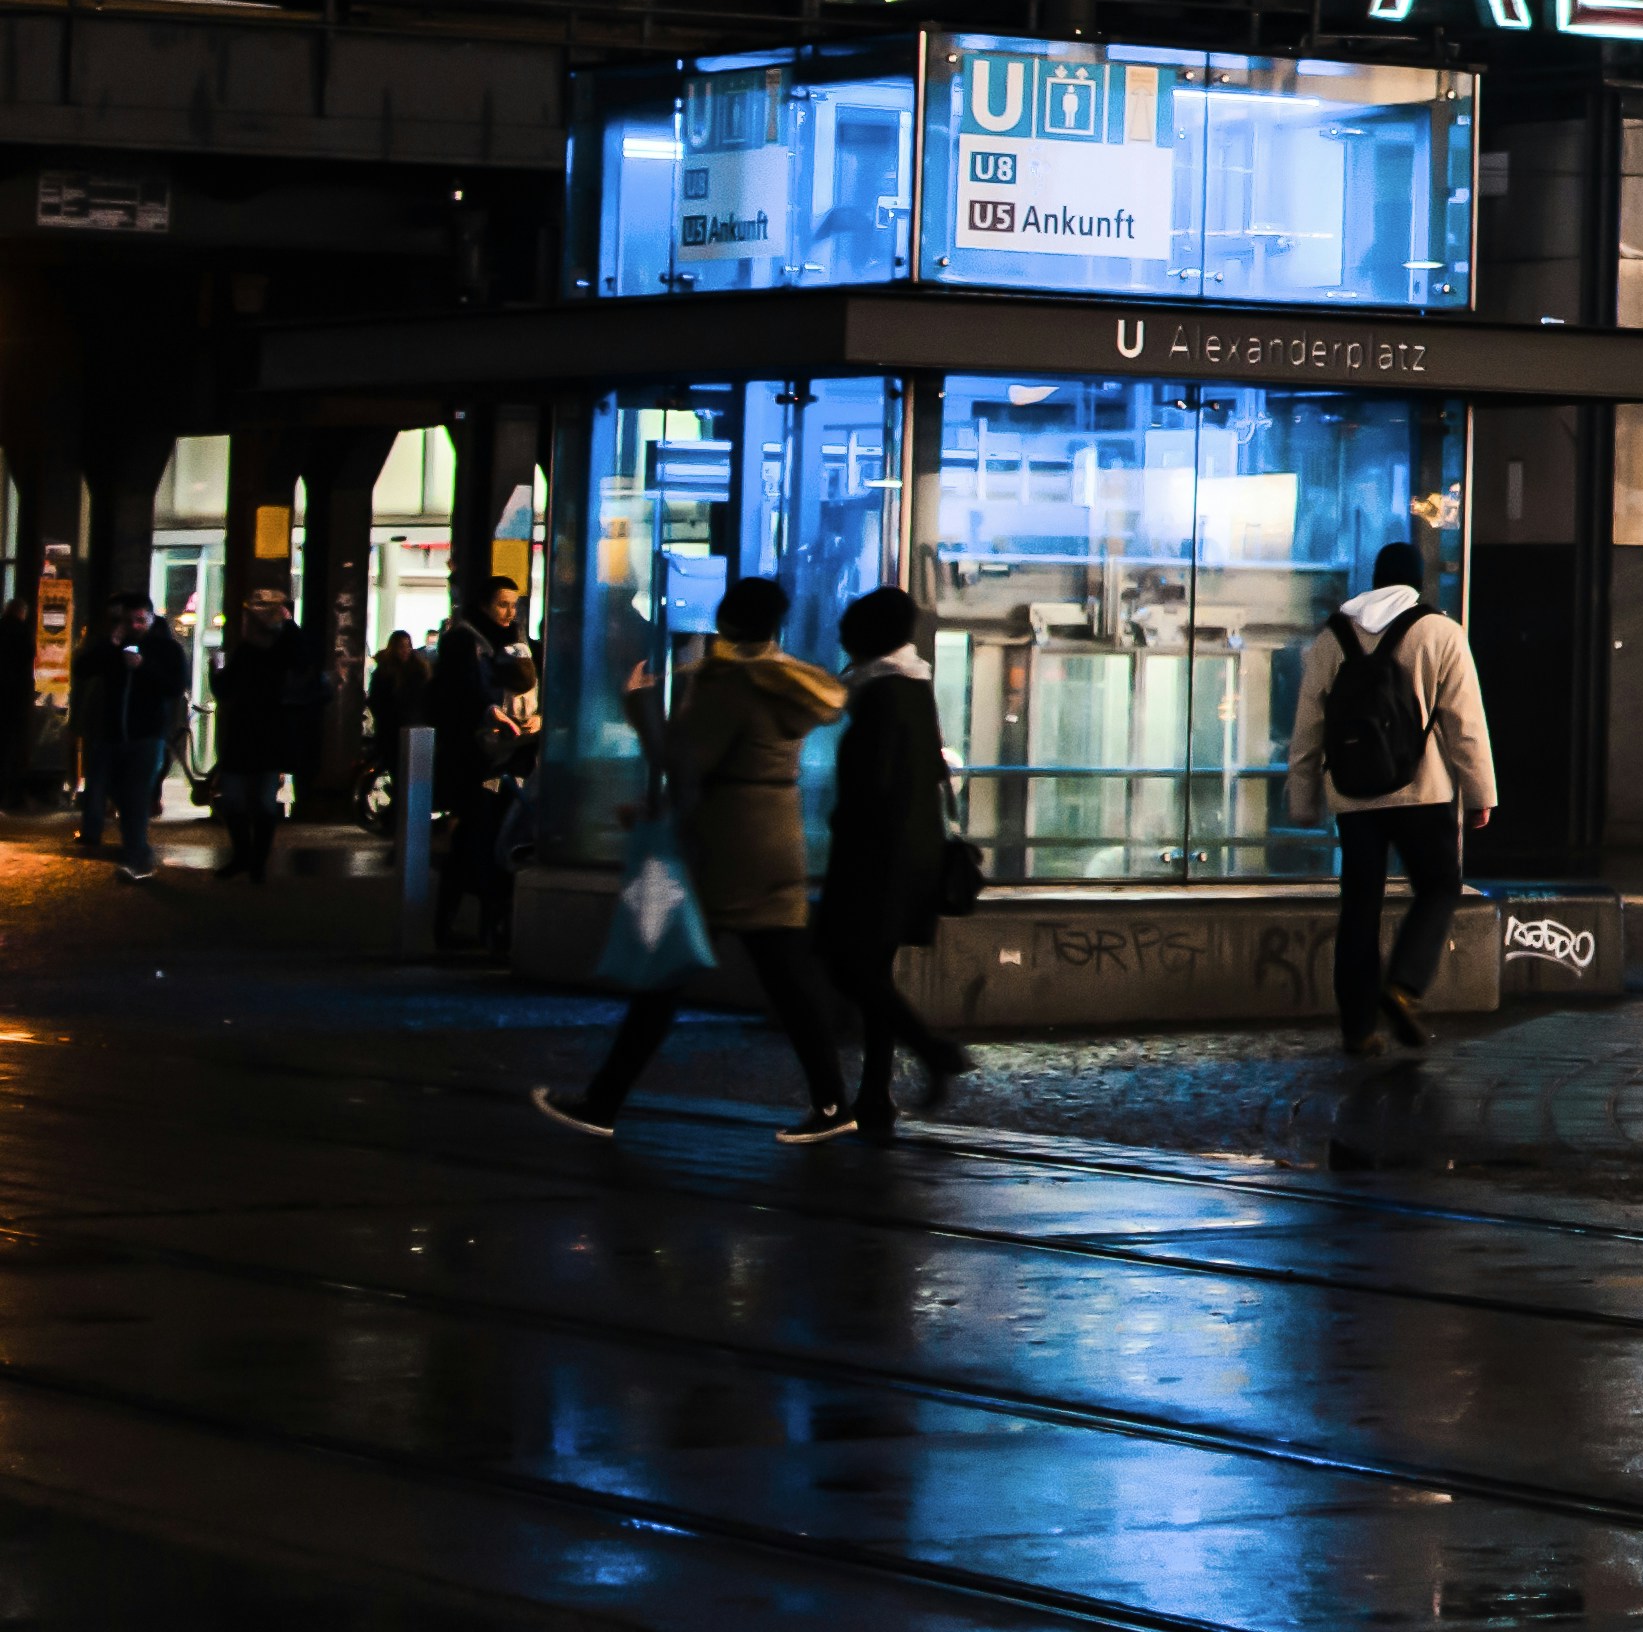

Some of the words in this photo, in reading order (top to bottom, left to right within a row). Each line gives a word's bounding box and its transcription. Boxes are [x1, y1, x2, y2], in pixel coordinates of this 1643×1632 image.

[973, 153, 1014, 182] U8
[972, 201, 1012, 230] U5
[1021, 204, 1136, 240] Ankunft
[1115, 318, 1146, 360] U
[1167, 323, 1428, 377] Alexanderplatz
